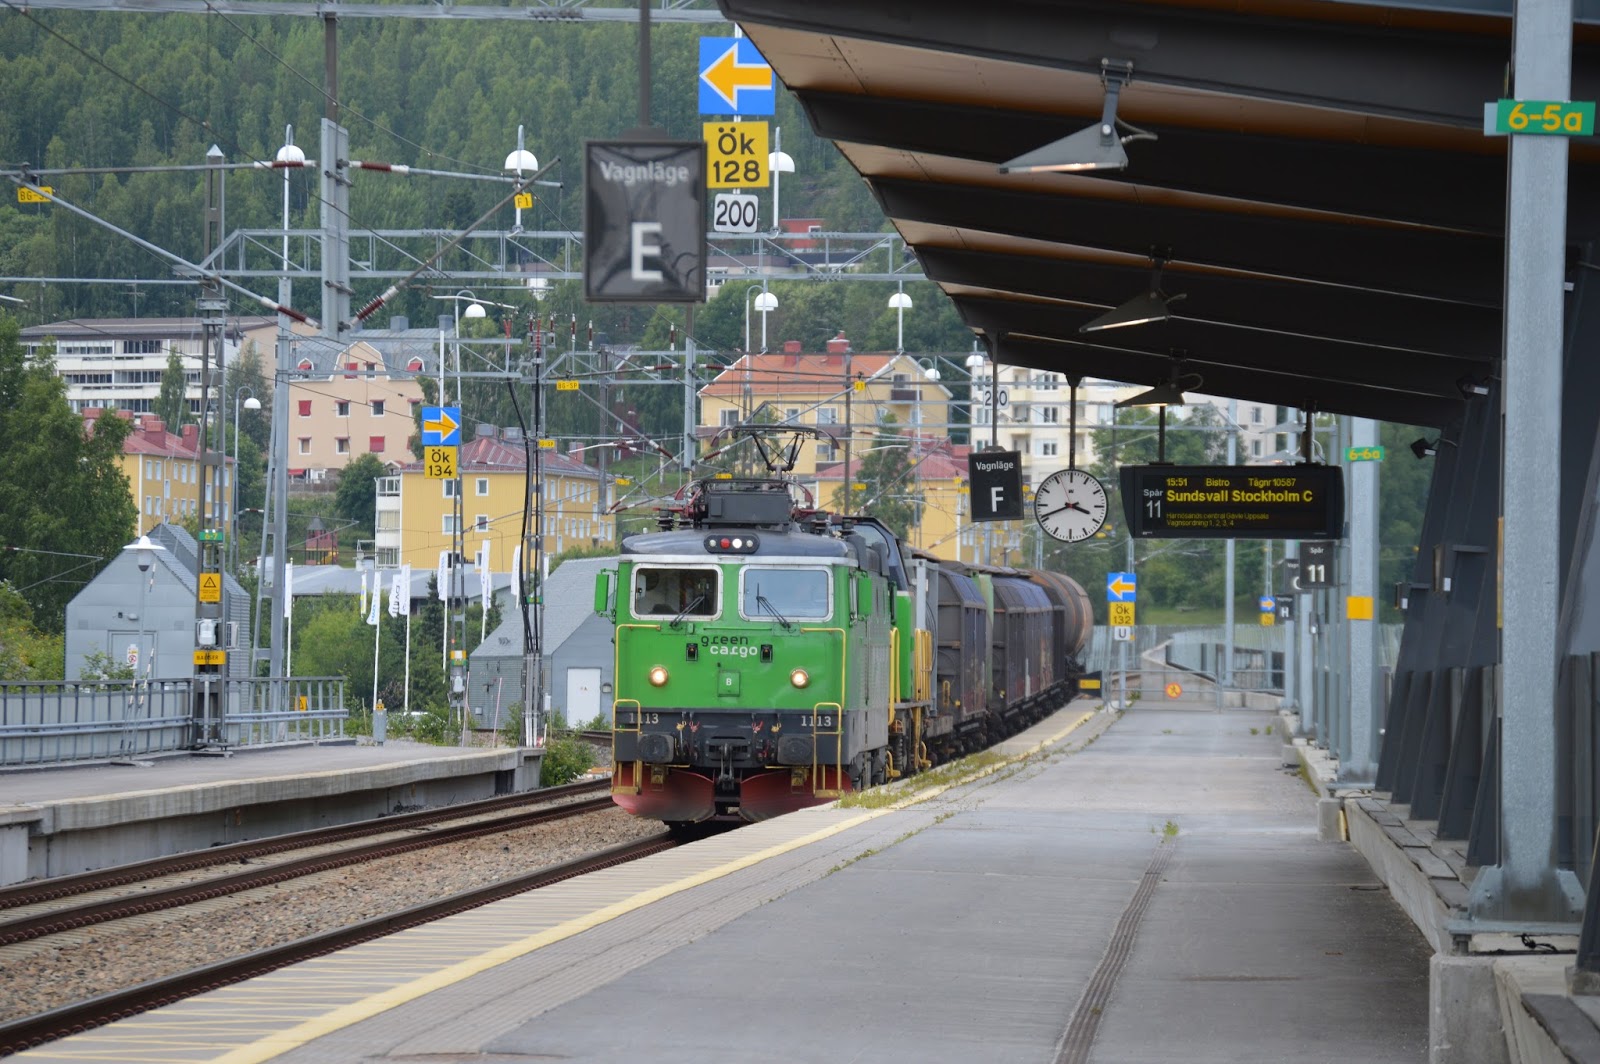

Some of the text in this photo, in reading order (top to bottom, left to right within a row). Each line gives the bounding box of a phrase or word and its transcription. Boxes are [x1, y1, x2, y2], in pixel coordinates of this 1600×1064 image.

[1508, 103, 1583, 132] 6-5a
[717, 126, 756, 156] Ök
[600, 160, 690, 186] Vagnläge
[713, 160, 761, 183] 128
[715, 200, 757, 228] 200
[631, 222, 663, 282] E
[984, 390, 1008, 406] 20
[431, 448, 450, 463] Ök
[1349, 448, 1380, 460] 6-6a
[428, 465, 453, 477] 134
[975, 460, 1014, 472] Vagnläge
[1166, 477, 1297, 489] 15:51 Bistro Tågnr 10587
[1143, 488, 1163, 498] Spår
[1166, 489, 1313, 502] Sundsvall Stockholm C
[990, 486, 1004, 513] F
[1146, 499, 1161, 518] 11
[1309, 546, 1324, 555] Spår
[1308, 564, 1325, 583] 11
[1115, 603, 1130, 615] Ök
[1280, 606, 1289, 618] H
[1113, 615, 1131, 625] 132
[1118, 628, 1127, 639] U
[701, 635, 749, 647] green
[709, 645, 758, 658] cargo
[725, 678, 732, 686] B
[628, 713, 660, 725] 1113
[800, 715, 832, 727] 1113
